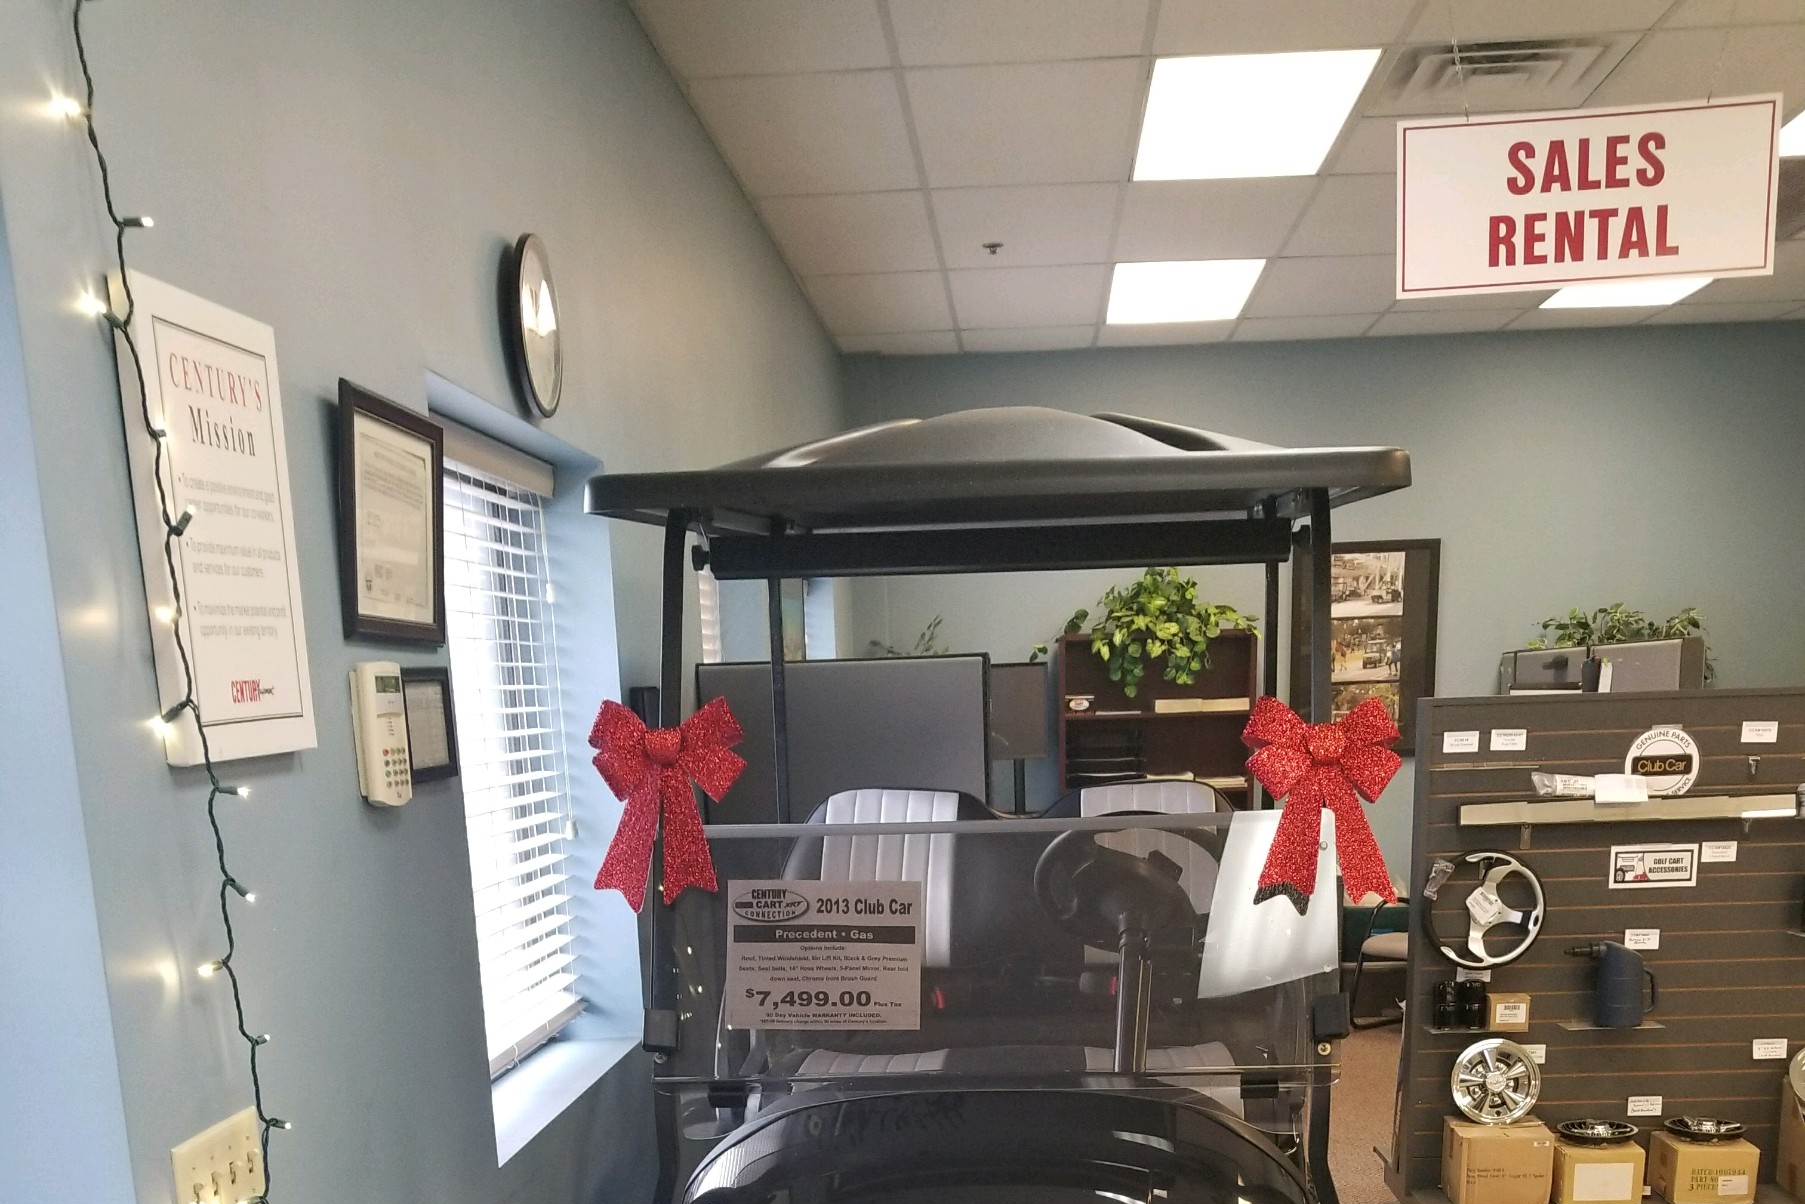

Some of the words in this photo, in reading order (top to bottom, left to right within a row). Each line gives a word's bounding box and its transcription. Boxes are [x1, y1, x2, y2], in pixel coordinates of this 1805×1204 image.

[1506, 132, 1666, 195] SALES
[1488, 204, 1680, 268] RENTAL
[169, 353, 262, 412] CENTURY'S
[188, 405, 256, 457] Mission
[231, 679, 261, 703] CENTURY
[1636, 730, 1670, 750] GENUINE
[1671, 731, 1692, 749] PARTS
[1638, 759, 1664, 772] Club
[1665, 758, 1686, 771] Car
[1668, 857, 1684, 865] CART
[752, 889, 787, 900] CENTURY
[756, 901, 783, 909] CART
[816, 898, 850, 914] 2013
[854, 899, 885, 915] Club
[888, 900, 913, 915] Car
[745, 910, 797, 920] CONNECTION
[775, 929, 838, 939] Precedent
[850, 930, 874, 940] Gas
[745, 988, 872, 1010] $7,499.00
